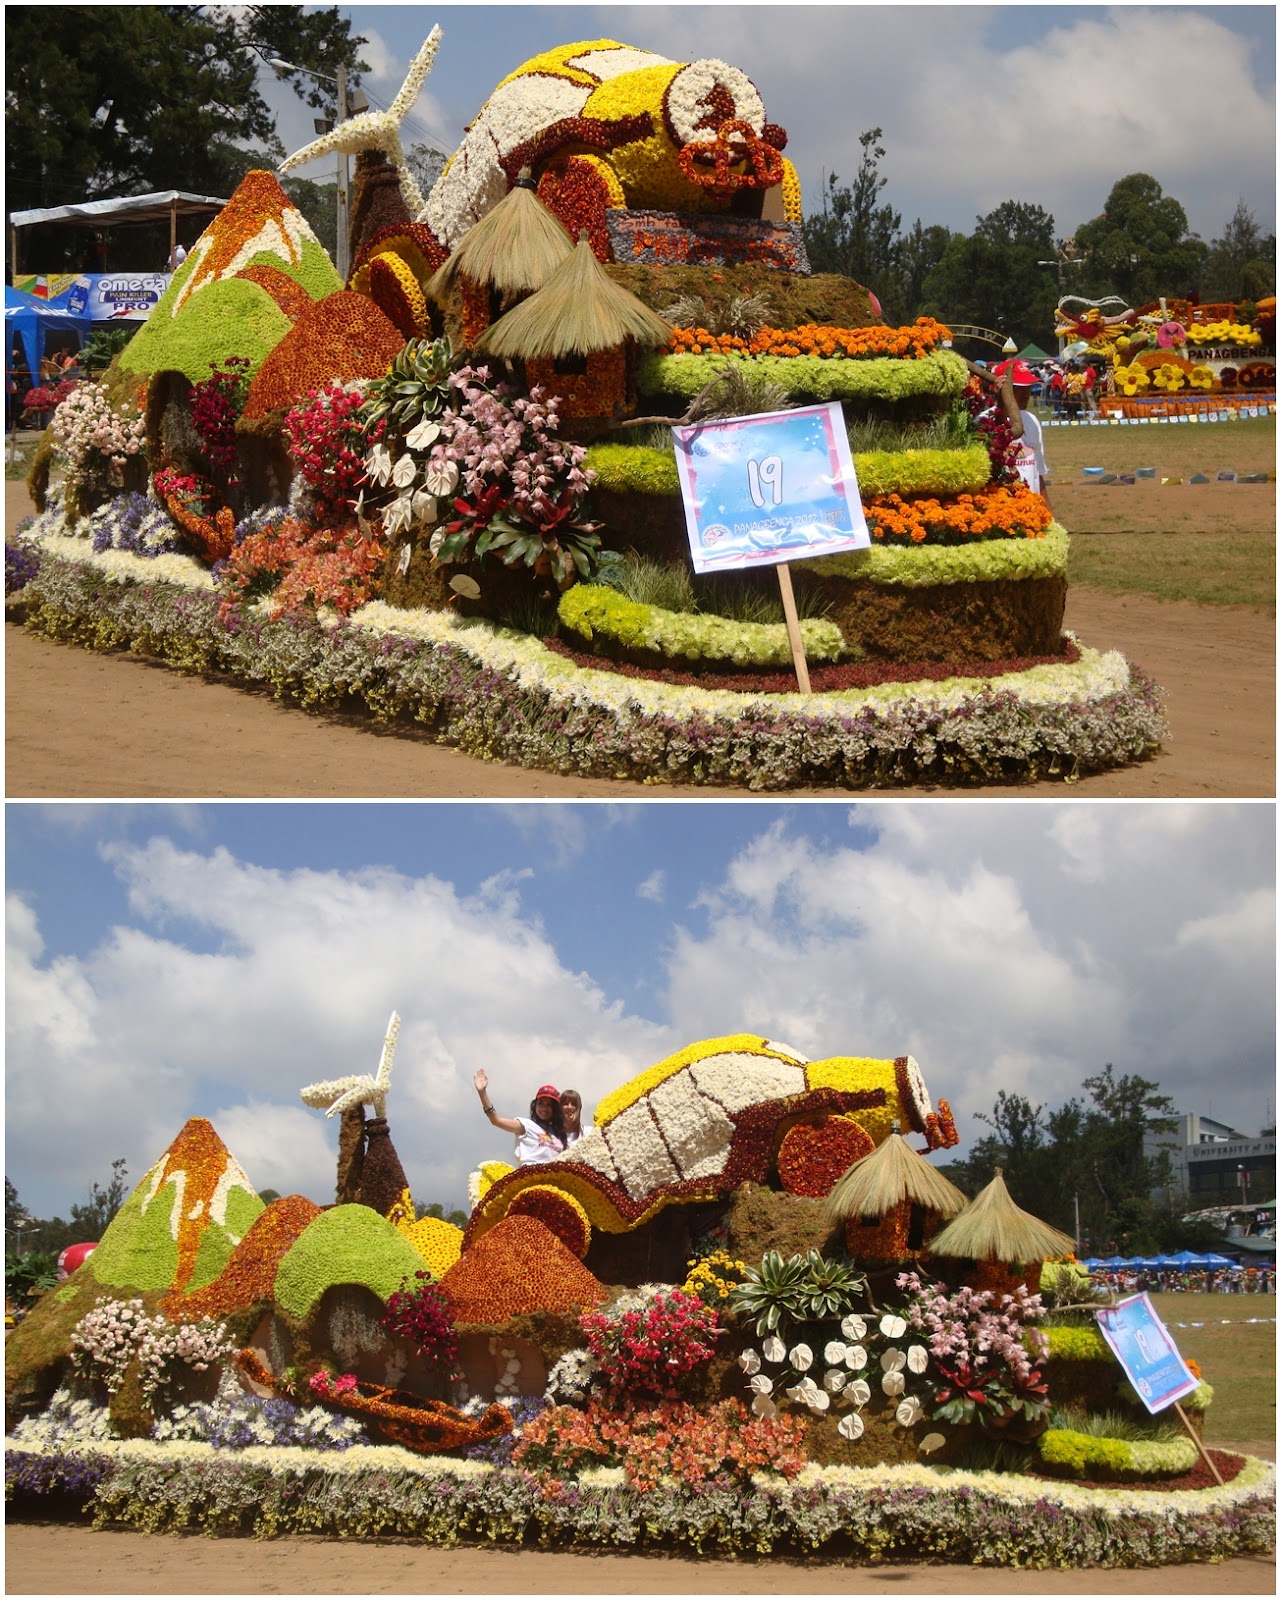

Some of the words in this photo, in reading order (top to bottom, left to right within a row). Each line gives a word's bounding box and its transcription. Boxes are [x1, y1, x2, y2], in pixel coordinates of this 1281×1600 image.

[97, 275, 167, 292] omega
[113, 302, 150, 311] PRO
[1188, 347, 1275, 360] PANAGBENGA
[747, 455, 783, 508] 19
[734, 517, 794, 534] PANAGBENGA
[795, 512, 818, 526] 2012
[1193, 1144, 1249, 1157] UNIVERSITY
